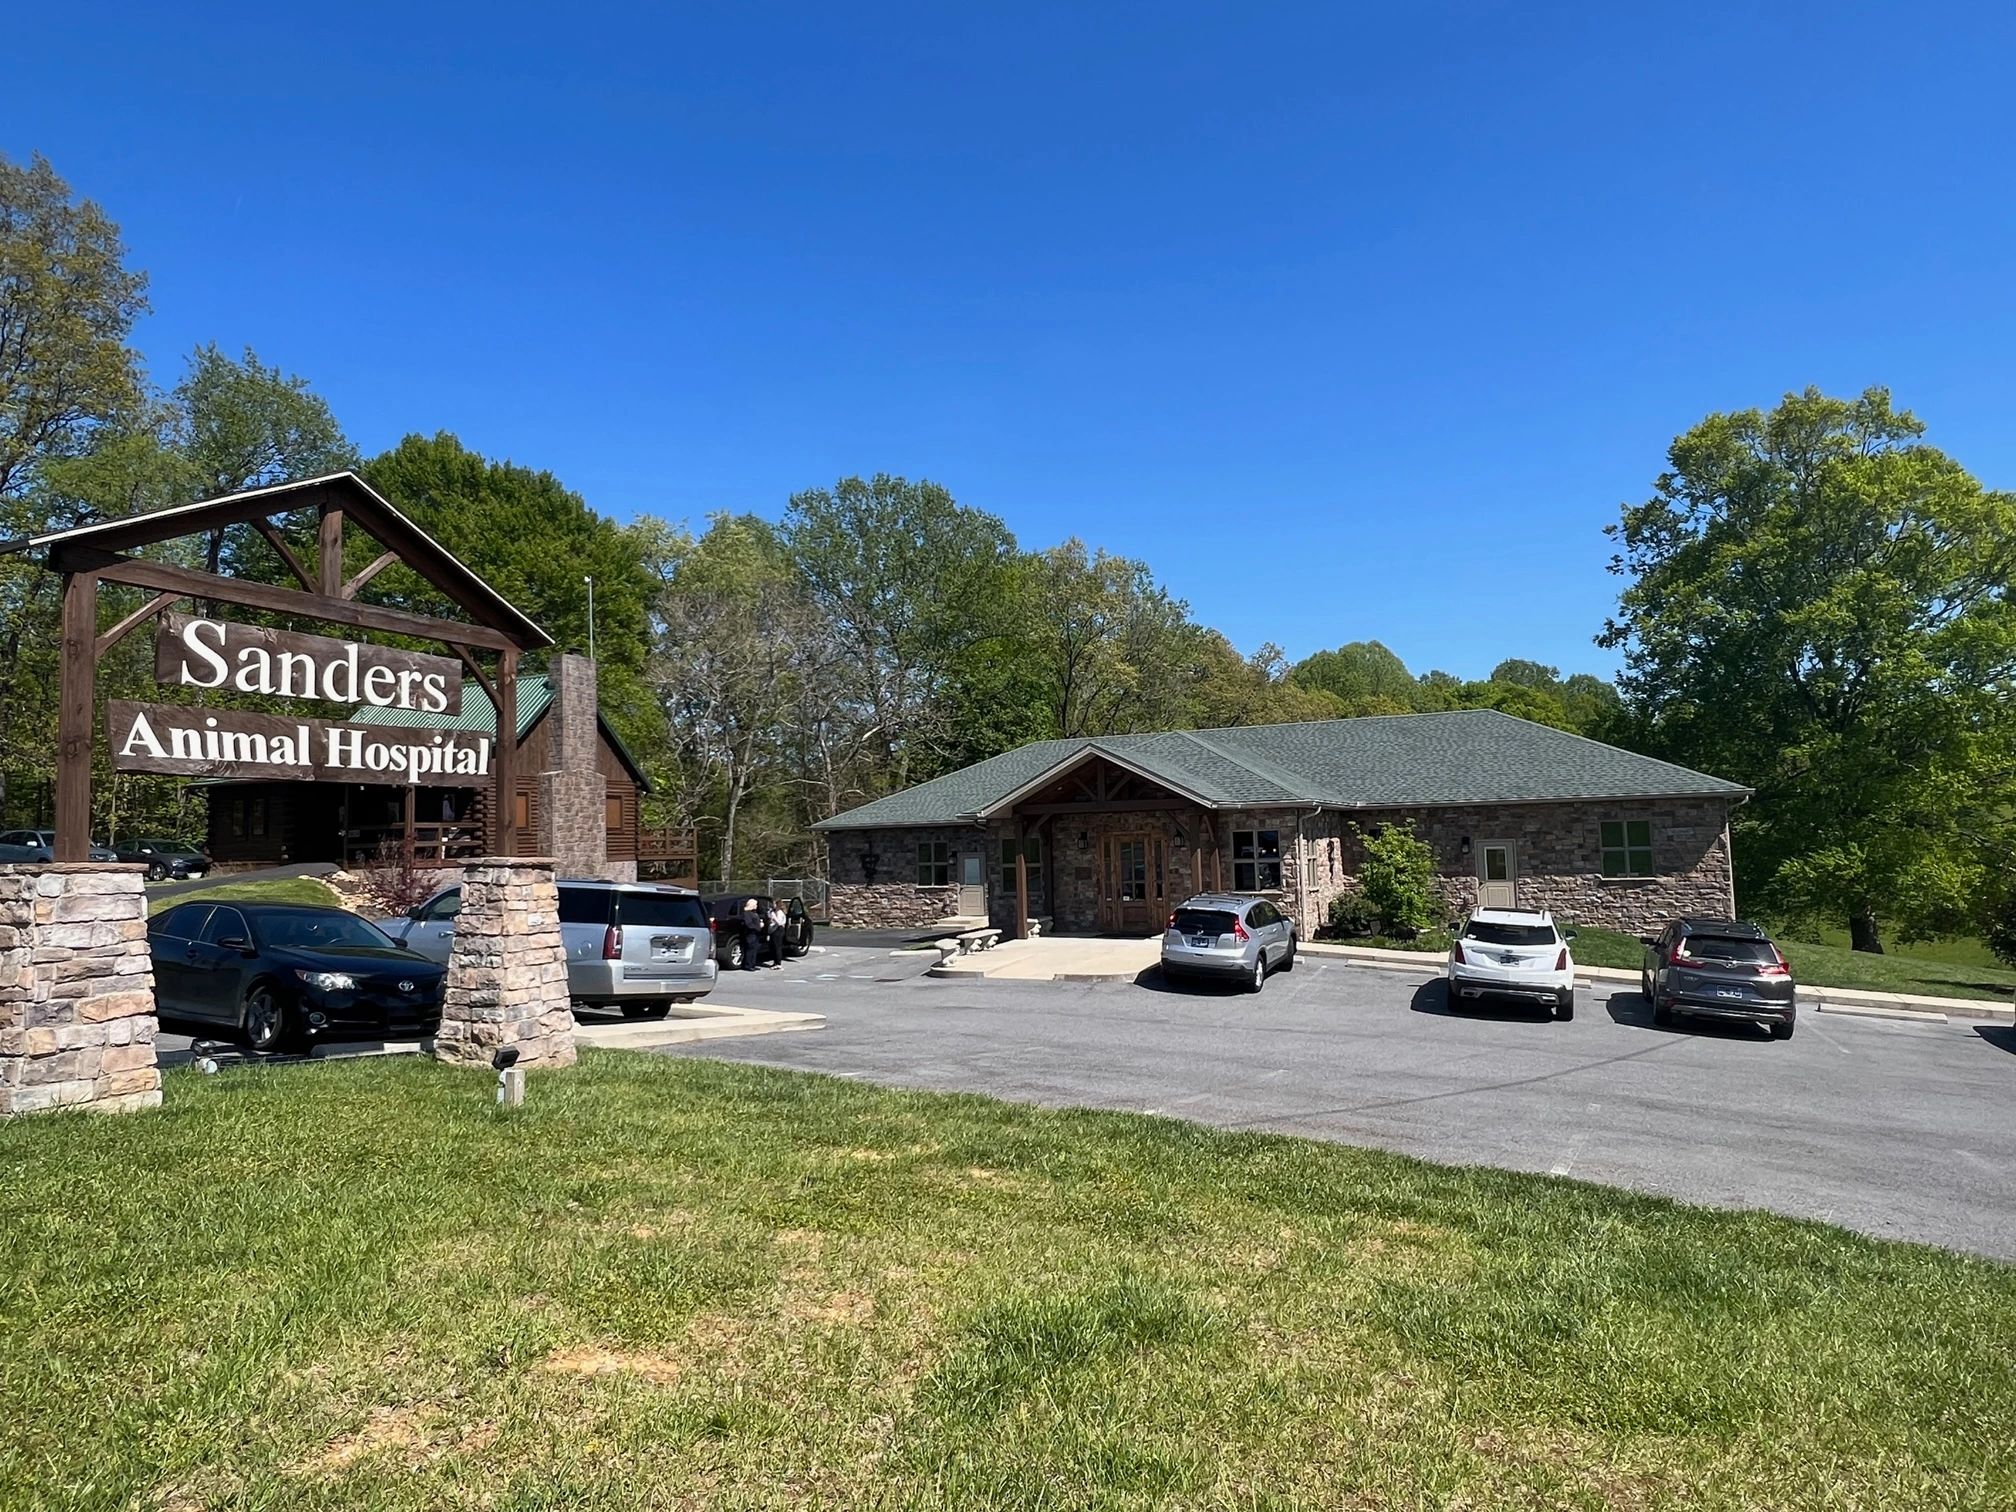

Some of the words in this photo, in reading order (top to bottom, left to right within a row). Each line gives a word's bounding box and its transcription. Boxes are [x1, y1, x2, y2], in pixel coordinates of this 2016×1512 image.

[180, 619, 448, 713] Sanders
[118, 711, 313, 767] Animal
[324, 727, 491, 783] Hospital
